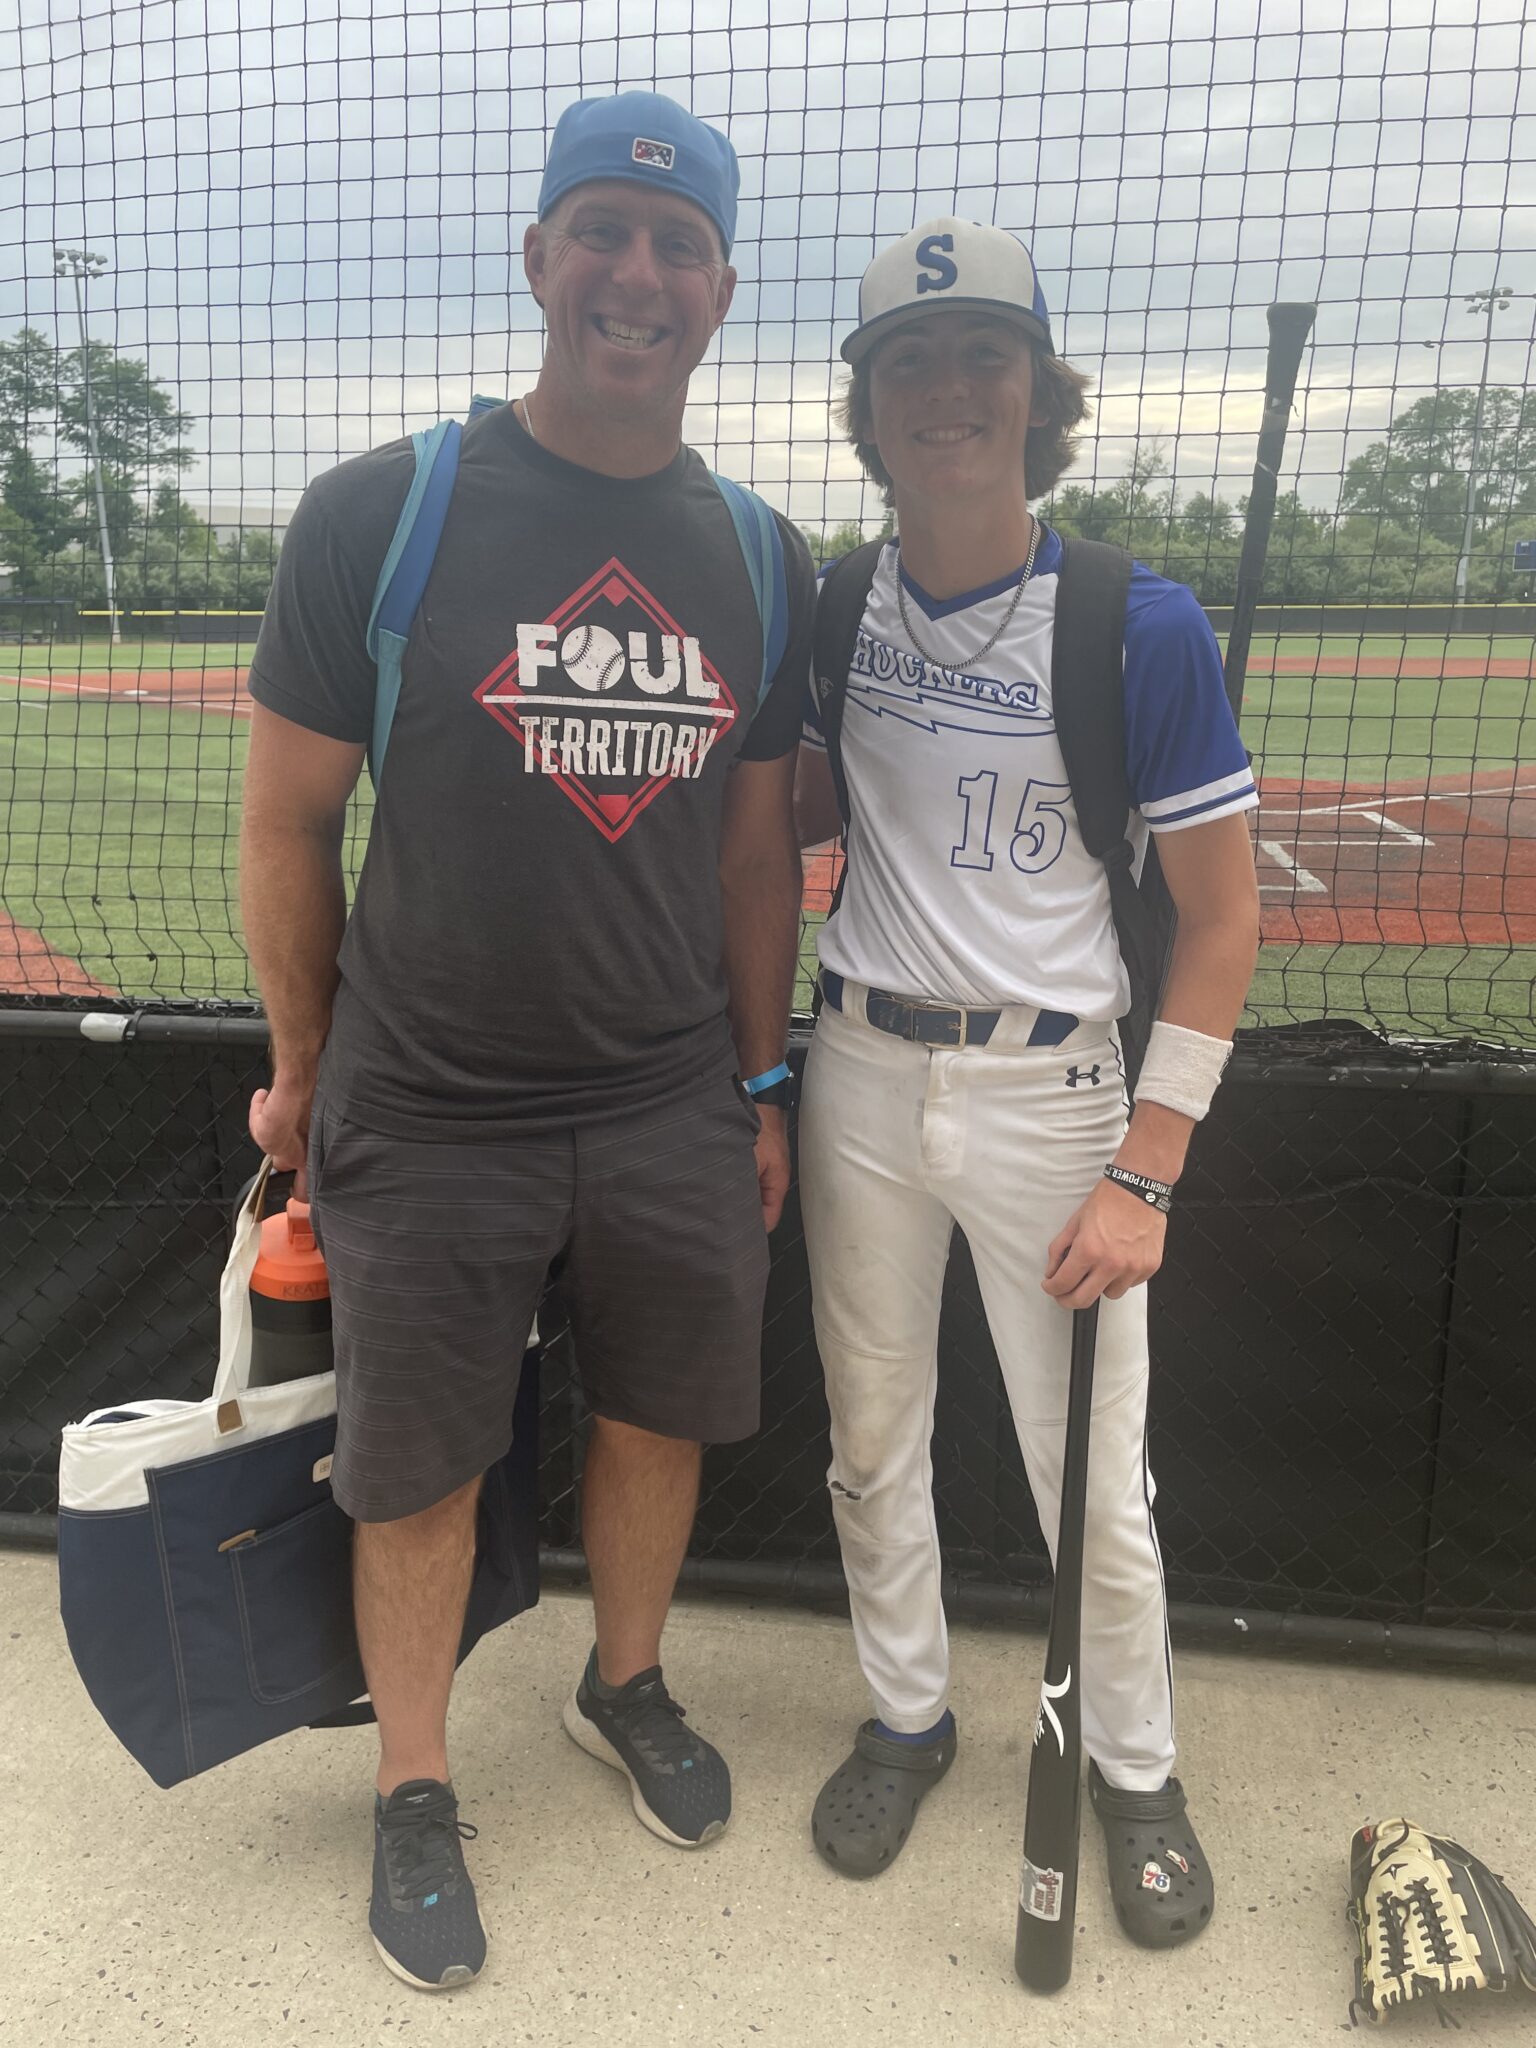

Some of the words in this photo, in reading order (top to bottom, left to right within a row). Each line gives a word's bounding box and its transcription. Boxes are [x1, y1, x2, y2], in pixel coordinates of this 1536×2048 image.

[914, 233, 958, 294] S
[516, 623, 720, 699] FOUL
[519, 716, 718, 779] TERRITORY
[950, 769, 1072, 874] 15
[1143, 1867, 1170, 1890] 76
